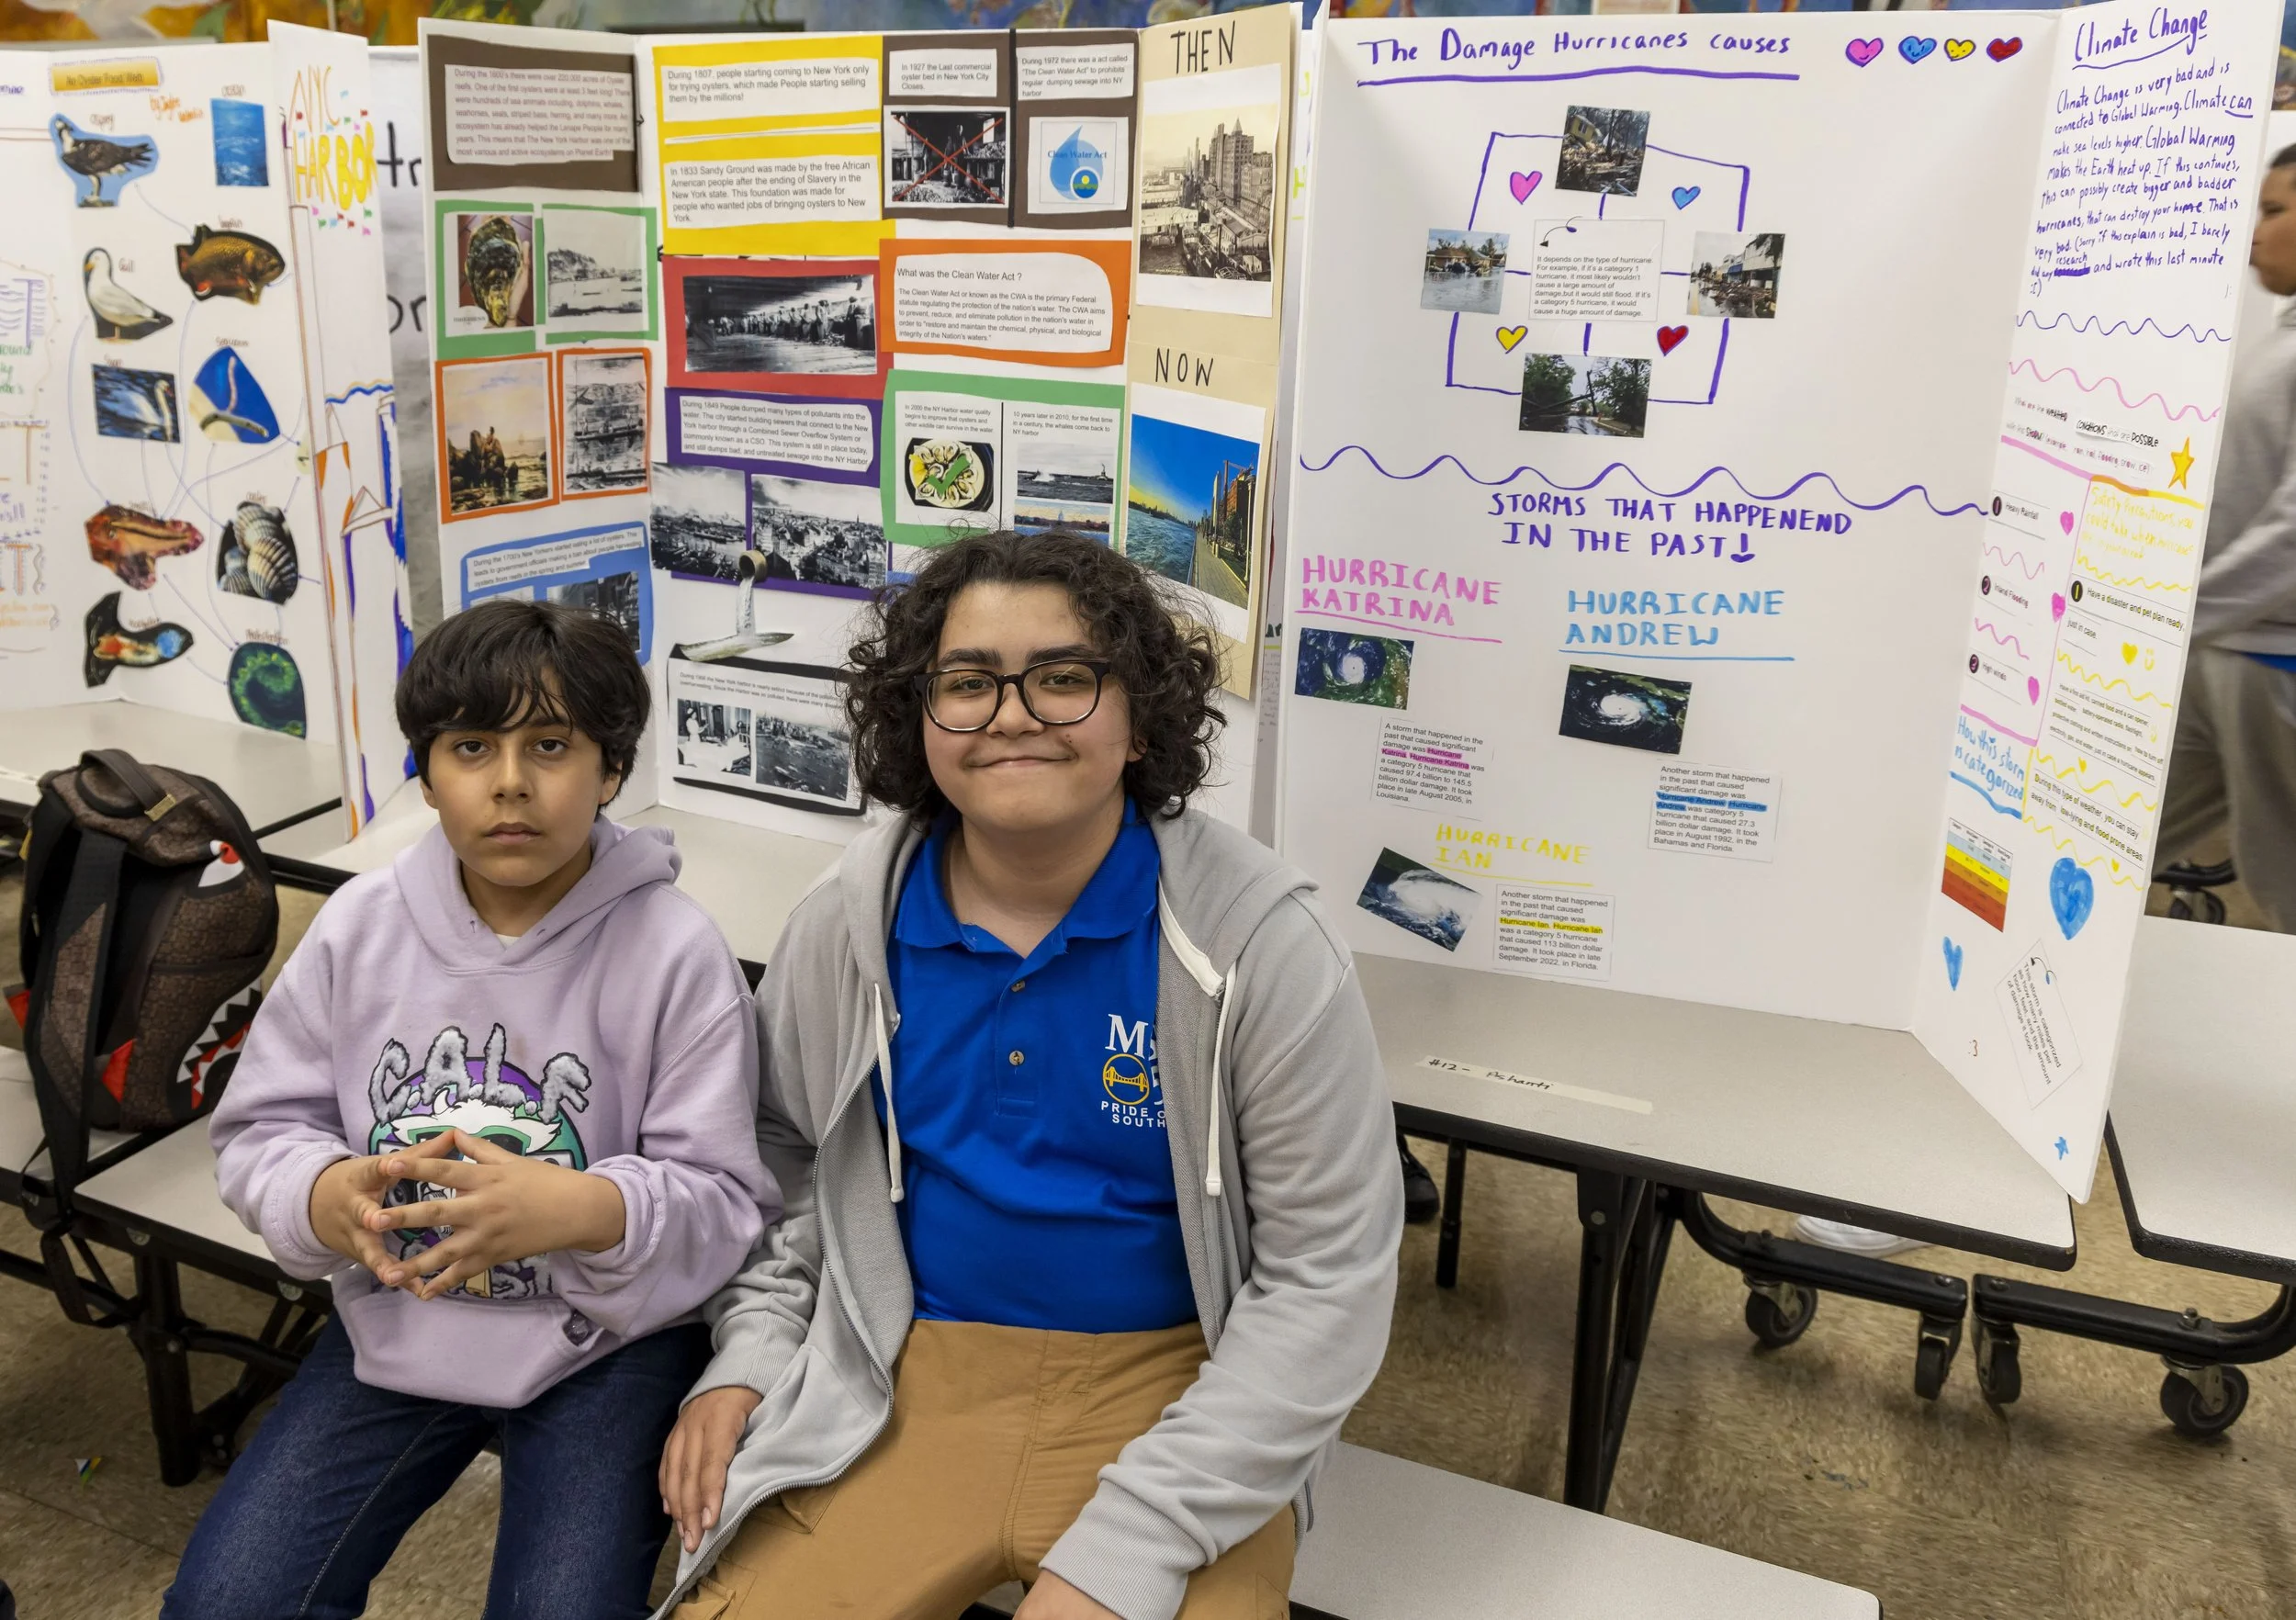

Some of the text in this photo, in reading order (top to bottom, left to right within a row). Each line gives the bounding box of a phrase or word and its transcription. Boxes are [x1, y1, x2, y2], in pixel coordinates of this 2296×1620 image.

[1169, 18, 1235, 74] THEN
[2076, 7, 2208, 61] Climate Change
[1357, 28, 1790, 71] The Damage Hurricanes causes
[668, 71, 692, 81] During
[716, 69, 741, 80] people
[744, 69, 771, 78] starting
[773, 68, 801, 77] coming
[803, 67, 811, 75] to
[813, 67, 831, 75] New
[833, 66, 850, 74] York
[852, 66, 869, 75] only
[901, 73, 920, 82] oyster
[975, 73, 988, 82] City
[2057, 57, 2230, 114] Climate Change is very bad and is
[2054, 112, 2094, 134] connected
[2099, 109, 2109, 125] to
[2111, 105, 2136, 121] Global
[2184, 84, 2226, 110] Climate
[2229, 96, 2253, 110] can
[1047, 150, 1108, 160] Clean Water Act
[2074, 140, 2087, 152] sea
[2090, 136, 2112, 151] levels
[2145, 125, 2186, 149] Global
[2189, 127, 2235, 156] Warming
[293, 121, 377, 210] HARBOR
[896, 268, 917, 277] What
[937, 270, 949, 278] the
[951, 271, 974, 279] Clean
[976, 272, 999, 280] Water
[1001, 273, 1015, 281] Act
[1017, 273, 1022, 281] ?
[1604, 265, 1633, 274] category
[1155, 348, 1213, 387] NOW
[1488, 492, 1852, 535] STORMS THAT HAPPENEND
[1502, 523, 1551, 547] IN
[1570, 529, 1631, 552] THE
[1302, 557, 1502, 606] HURRICANE
[1302, 589, 1455, 626] KATRINA
[1568, 590, 1784, 615] HURRICANE
[2087, 587, 2100, 600] Have
[2106, 594, 2128, 610] disaster
[2129, 604, 2141, 614] and
[2142, 609, 2152, 618] pet
[2152, 612, 2165, 623] plan
[1565, 621, 1718, 646] ANDREW
[2066, 621, 2077, 631] just
[2077, 624, 2083, 633] in
[1382, 740, 1410, 750] damage
[1426, 748, 1462, 759] Hurricane
[1414, 738, 1440, 747] caused
[1441, 742, 1476, 752] significant
[1427, 730, 1462, 741] happened
[1958, 714, 2024, 782] How this storm
[1660, 766, 1690, 775] Another
[1731, 773, 1770, 783] happened
[1964, 754, 2024, 801] categorized
[1434, 848, 1493, 871] IAN
[1435, 826, 1591, 865] HURRICANE
[1499, 917, 1536, 927] Hurricane
[1553, 923, 1589, 932] Hurricane
[1101, 1100, 1148, 1118] PRIDE
